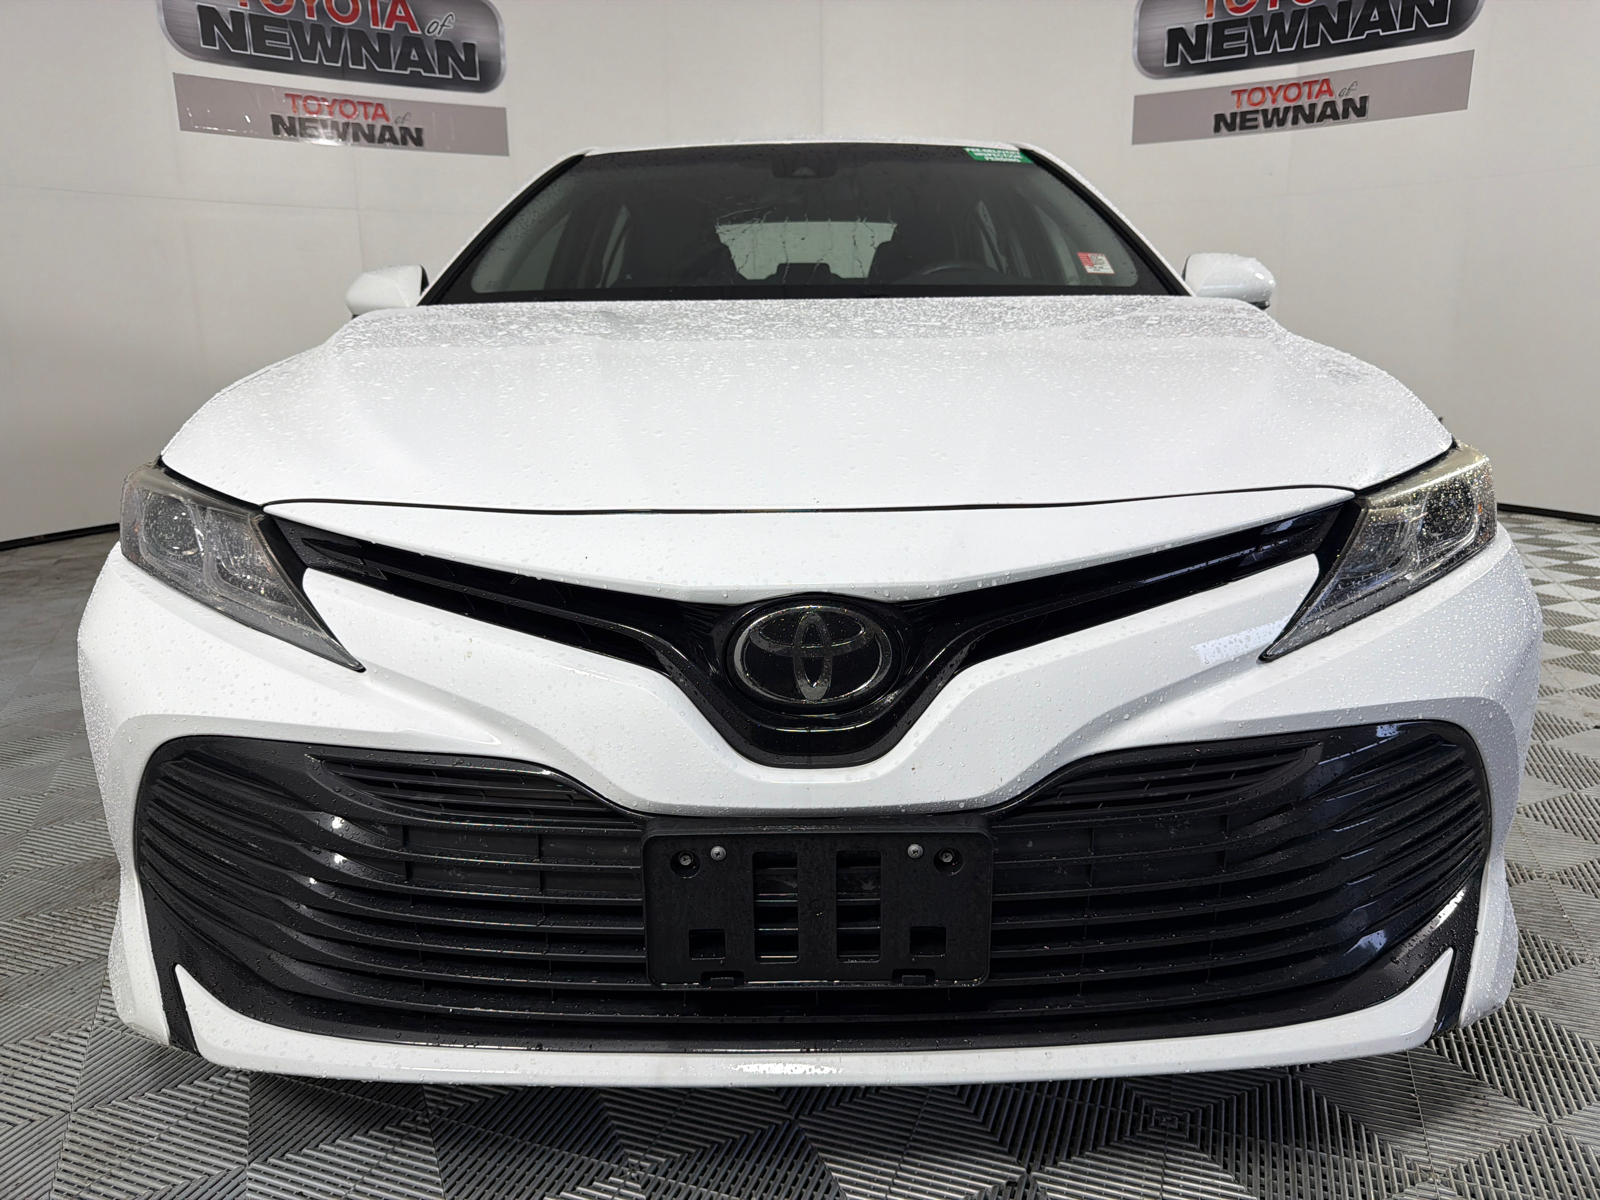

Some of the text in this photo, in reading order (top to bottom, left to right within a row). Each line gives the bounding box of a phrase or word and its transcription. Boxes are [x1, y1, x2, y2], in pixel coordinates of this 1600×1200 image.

[237, 0, 454, 36] OTA of
[1164, 0, 1451, 67] NEWNAN
[197, 4, 481, 81] NEWNAN
[284, 93, 390, 122] TOYOTA
[1231, 78, 1358, 109] TOYOTA of
[270, 114, 424, 147] NEWNAN
[1213, 95, 1369, 134] NEWNAN
